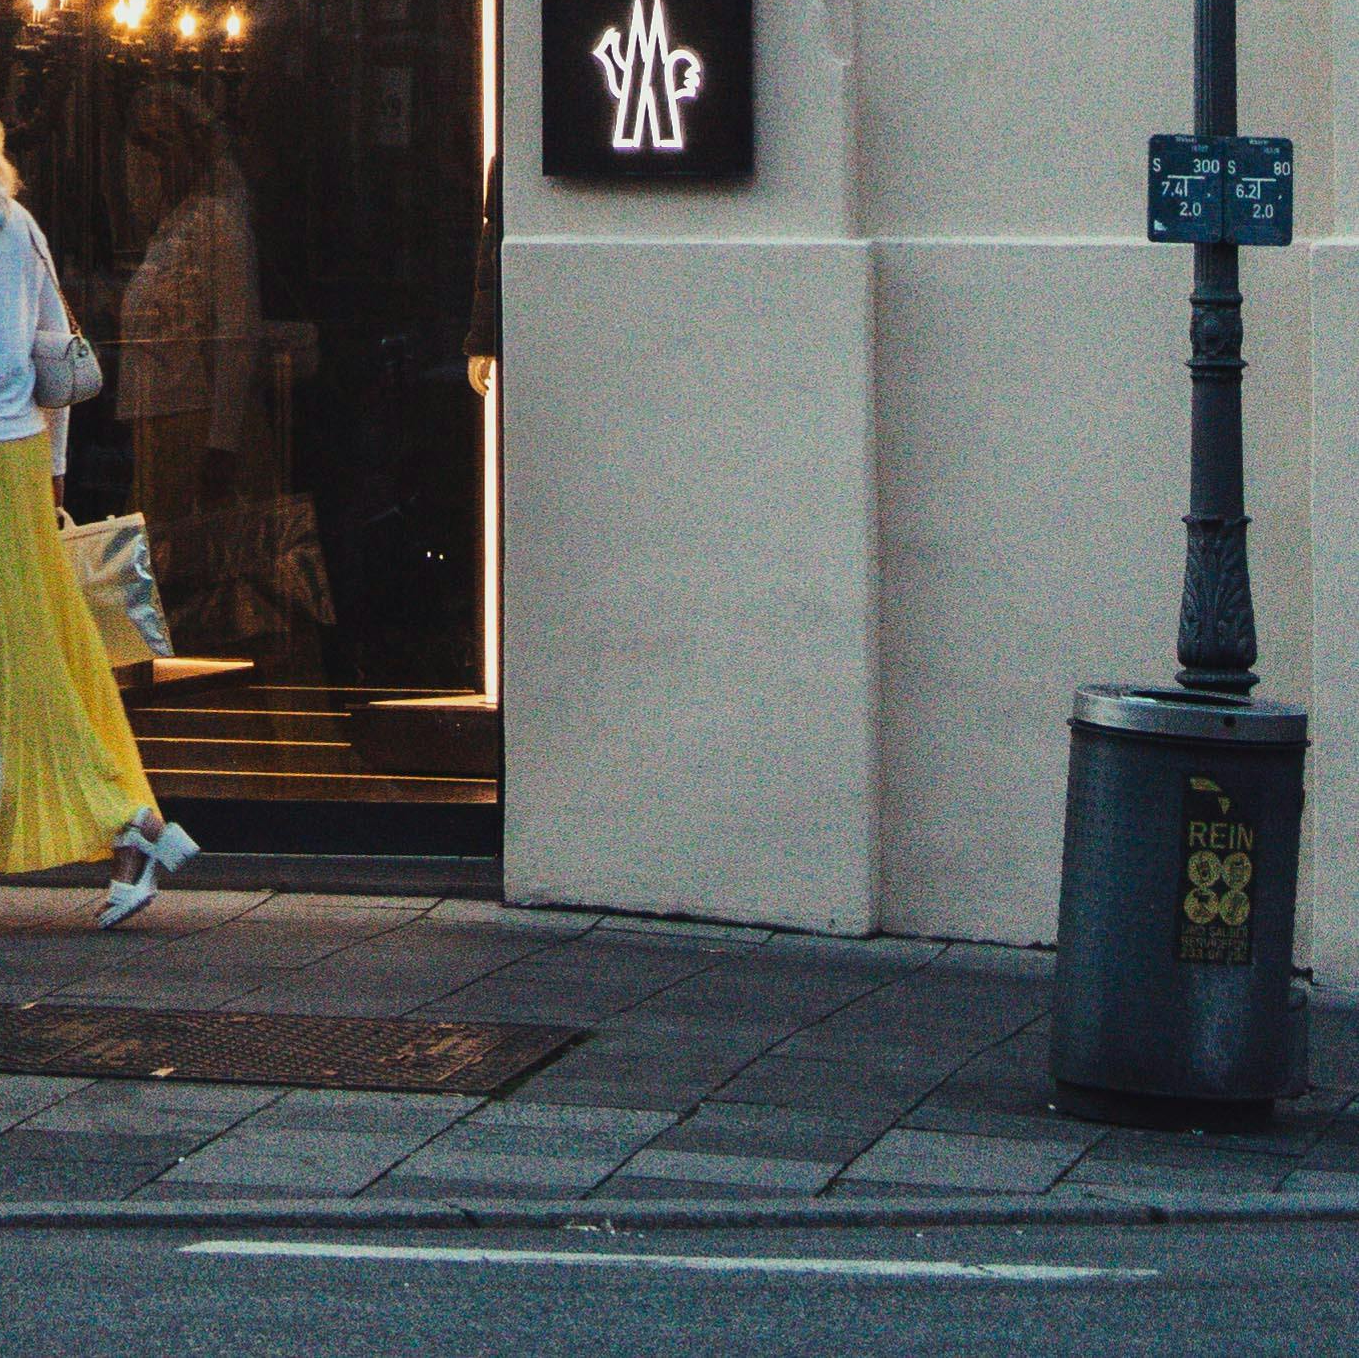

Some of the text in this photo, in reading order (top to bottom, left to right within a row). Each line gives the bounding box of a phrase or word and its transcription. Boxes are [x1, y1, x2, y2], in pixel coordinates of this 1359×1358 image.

[1152, 158, 1220, 174] S 300
[1227, 159, 1291, 176] S 80
[1179, 201, 1202, 217] 2.0
[1253, 204, 1274, 219] 2.0
[1189, 821, 1254, 850] REIN
